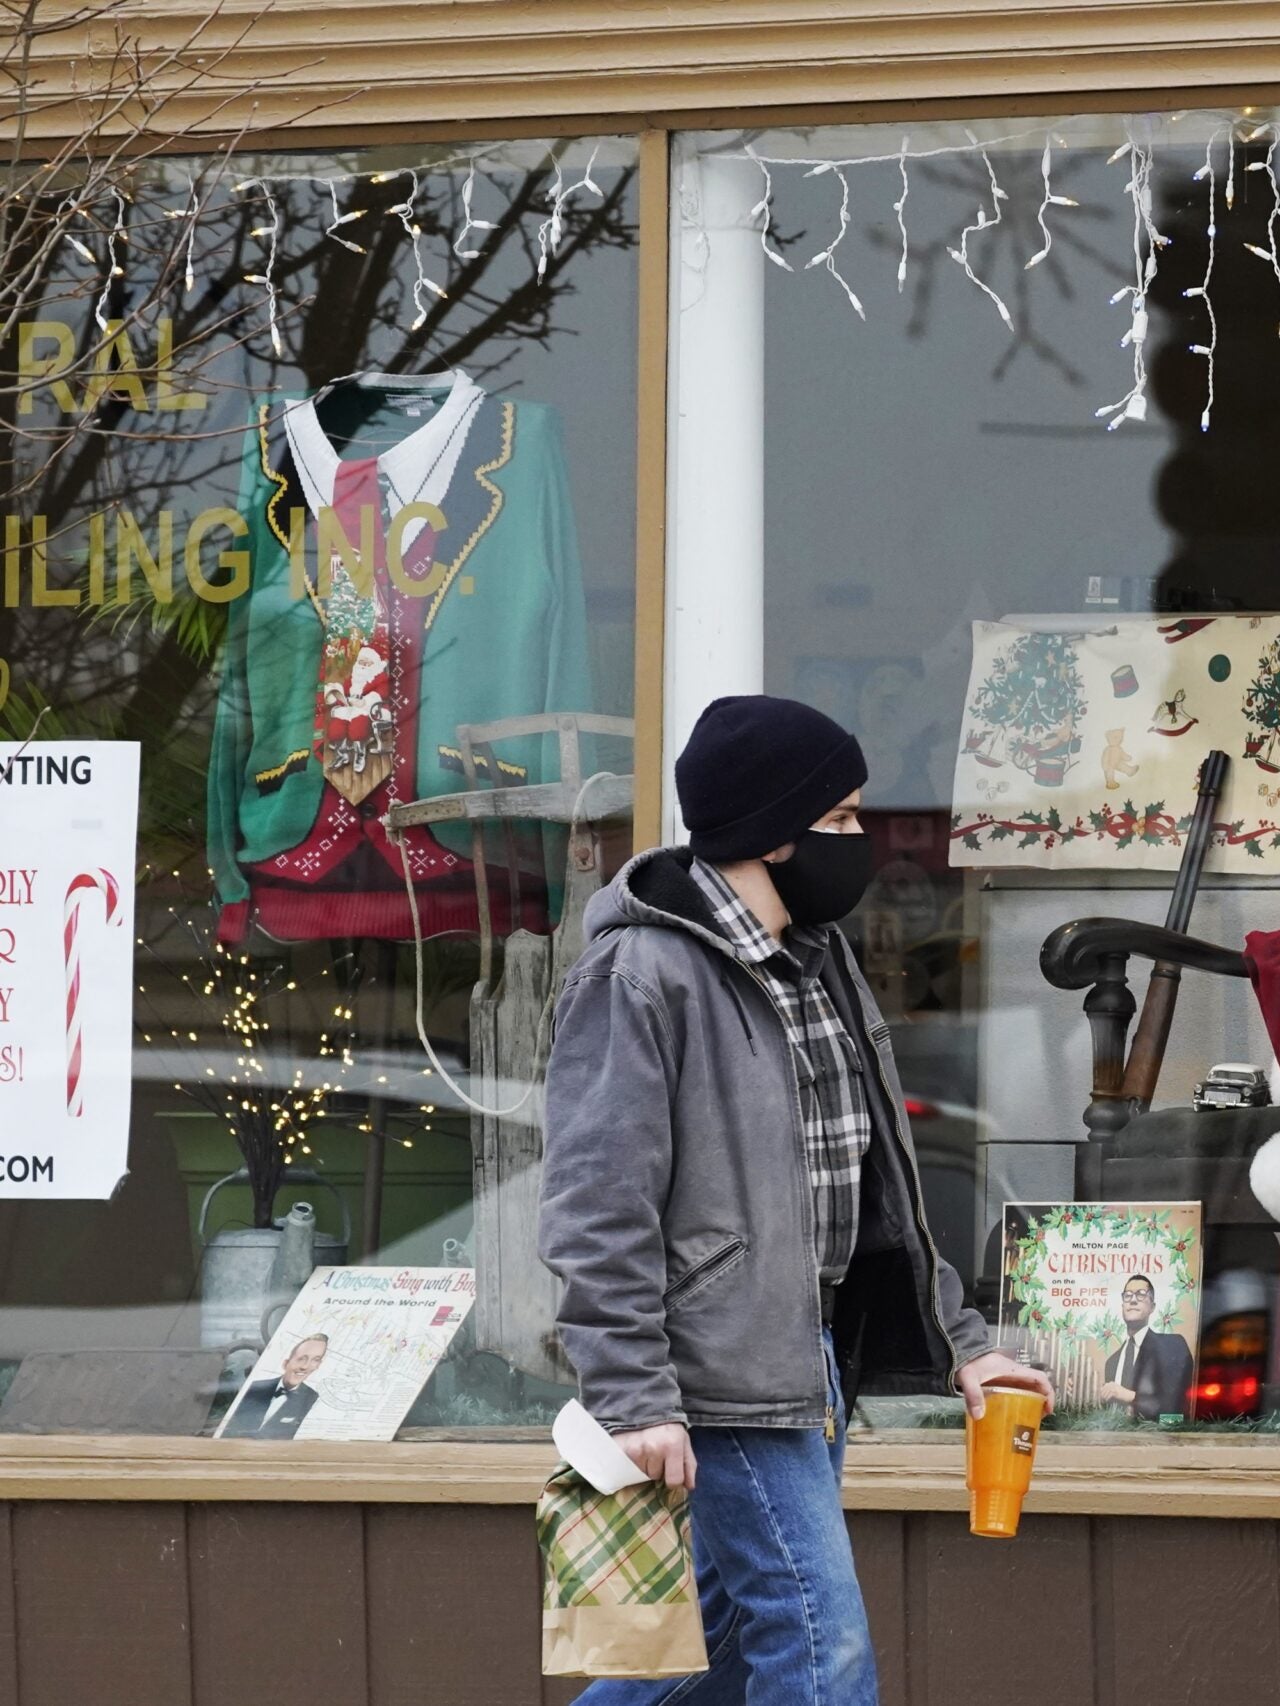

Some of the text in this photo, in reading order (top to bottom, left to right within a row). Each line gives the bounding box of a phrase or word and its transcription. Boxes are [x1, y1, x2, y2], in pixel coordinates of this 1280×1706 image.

[0, 318, 207, 415] RAL
[5, 502, 475, 608] ILING INC.
[1047, 1253, 1164, 1274] CHRISTMAS
[422, 1272, 453, 1293] with
[1051, 1287, 1108, 1297] BIG PIPE
[323, 1297, 437, 1307] Around the World
[1062, 1298, 1107, 1307] ORGAN
